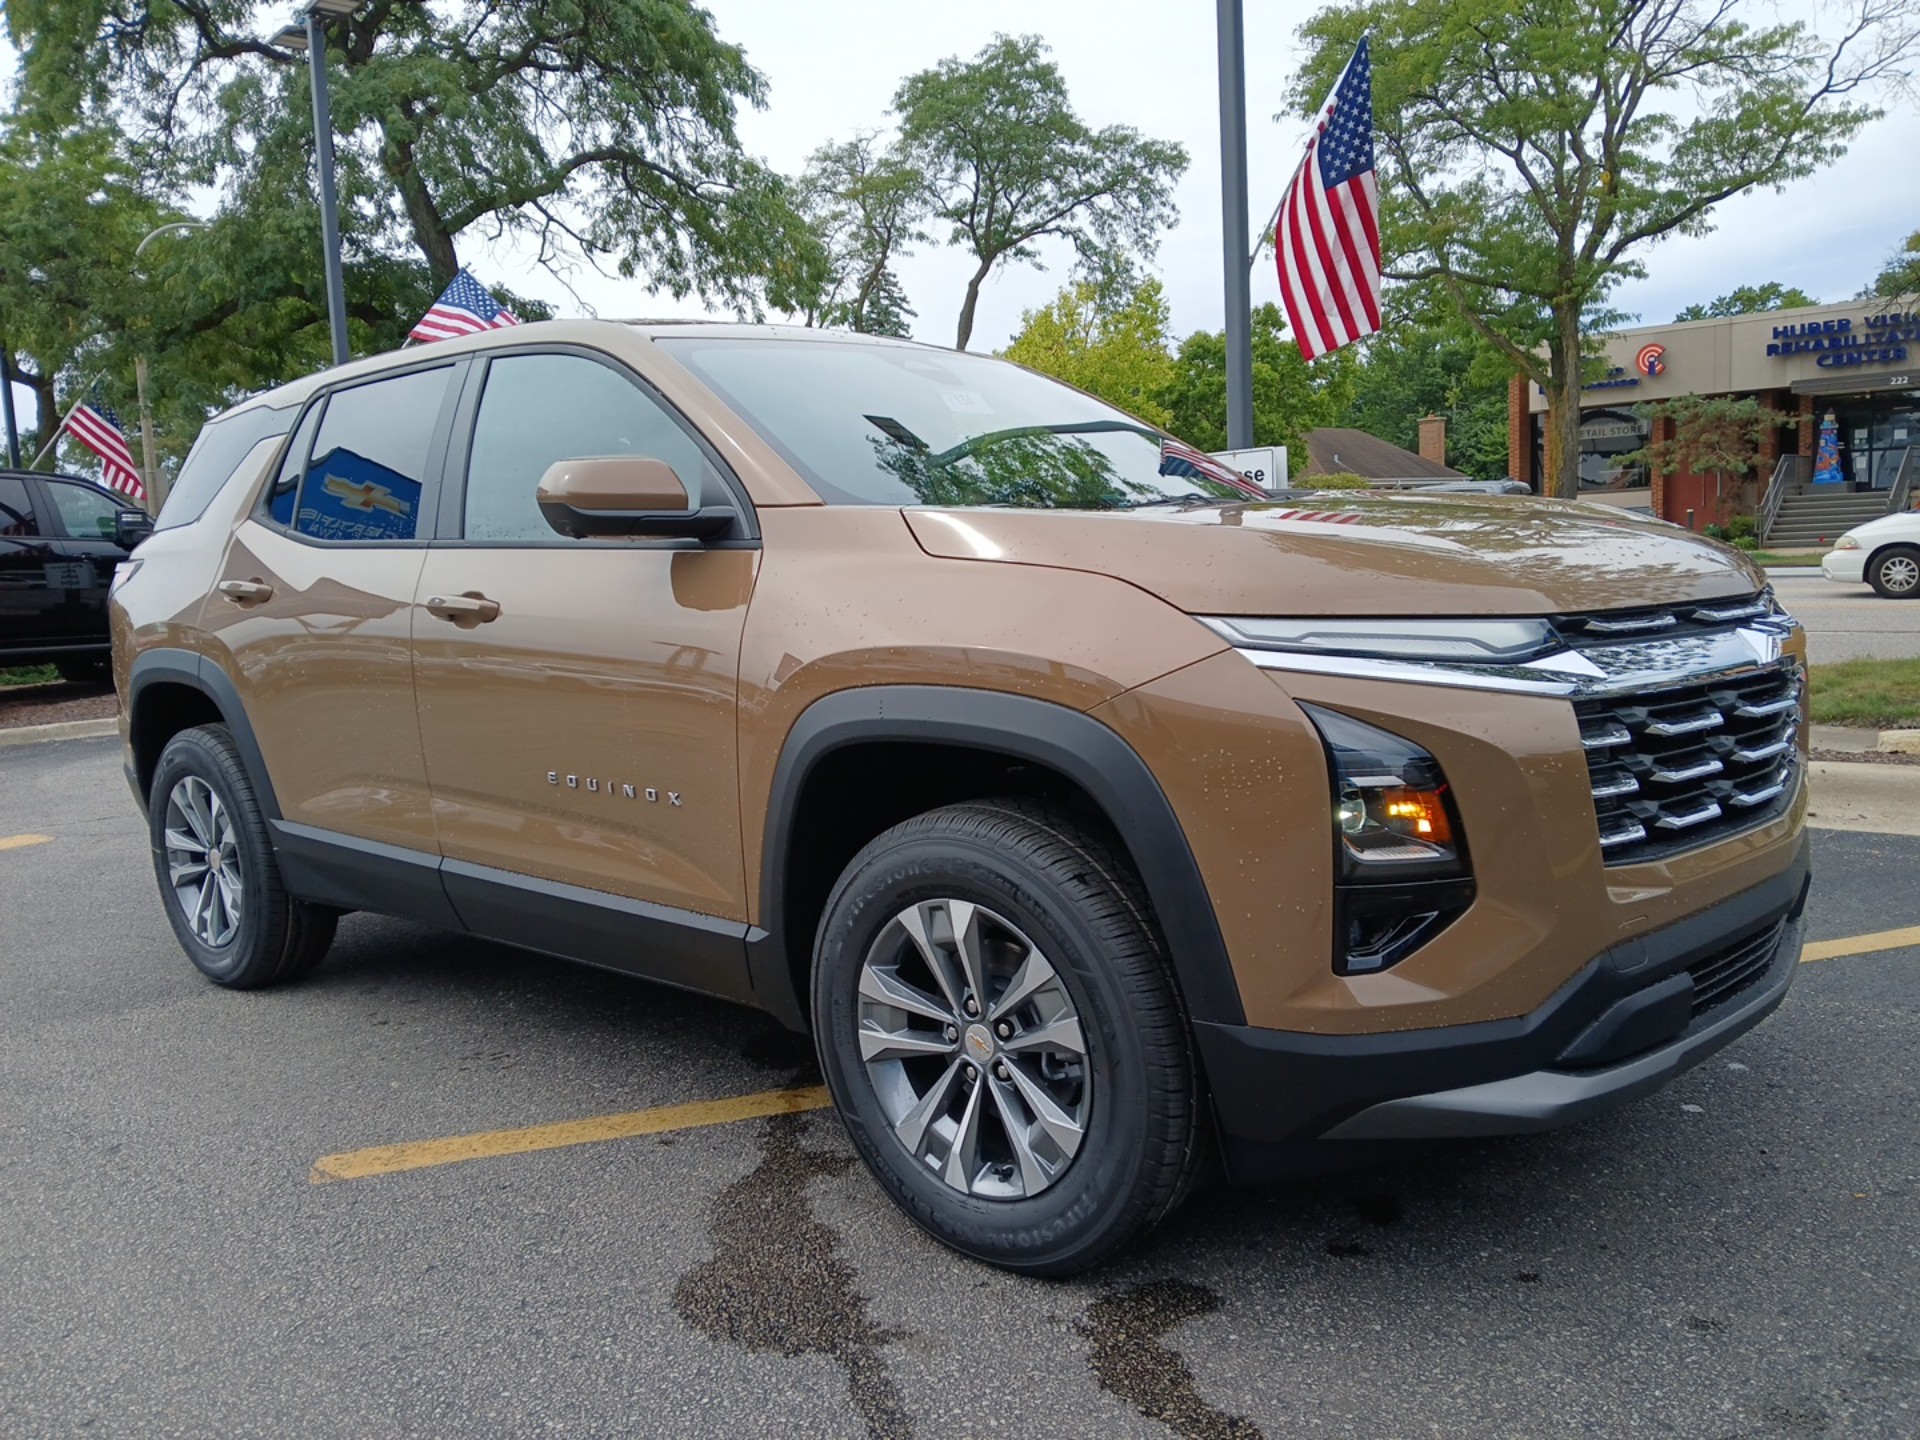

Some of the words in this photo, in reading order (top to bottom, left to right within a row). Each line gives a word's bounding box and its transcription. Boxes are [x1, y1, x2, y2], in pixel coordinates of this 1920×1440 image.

[1772, 318, 1852, 340] HUBER
[1816, 347, 1908, 368] CENTER
[1890, 376, 1909, 386] 222
[1580, 428, 1607, 438] ETAIL
[1610, 425, 1643, 436] STORE
[1238, 469, 1265, 482] se
[547, 771, 682, 807] EQUINOX
